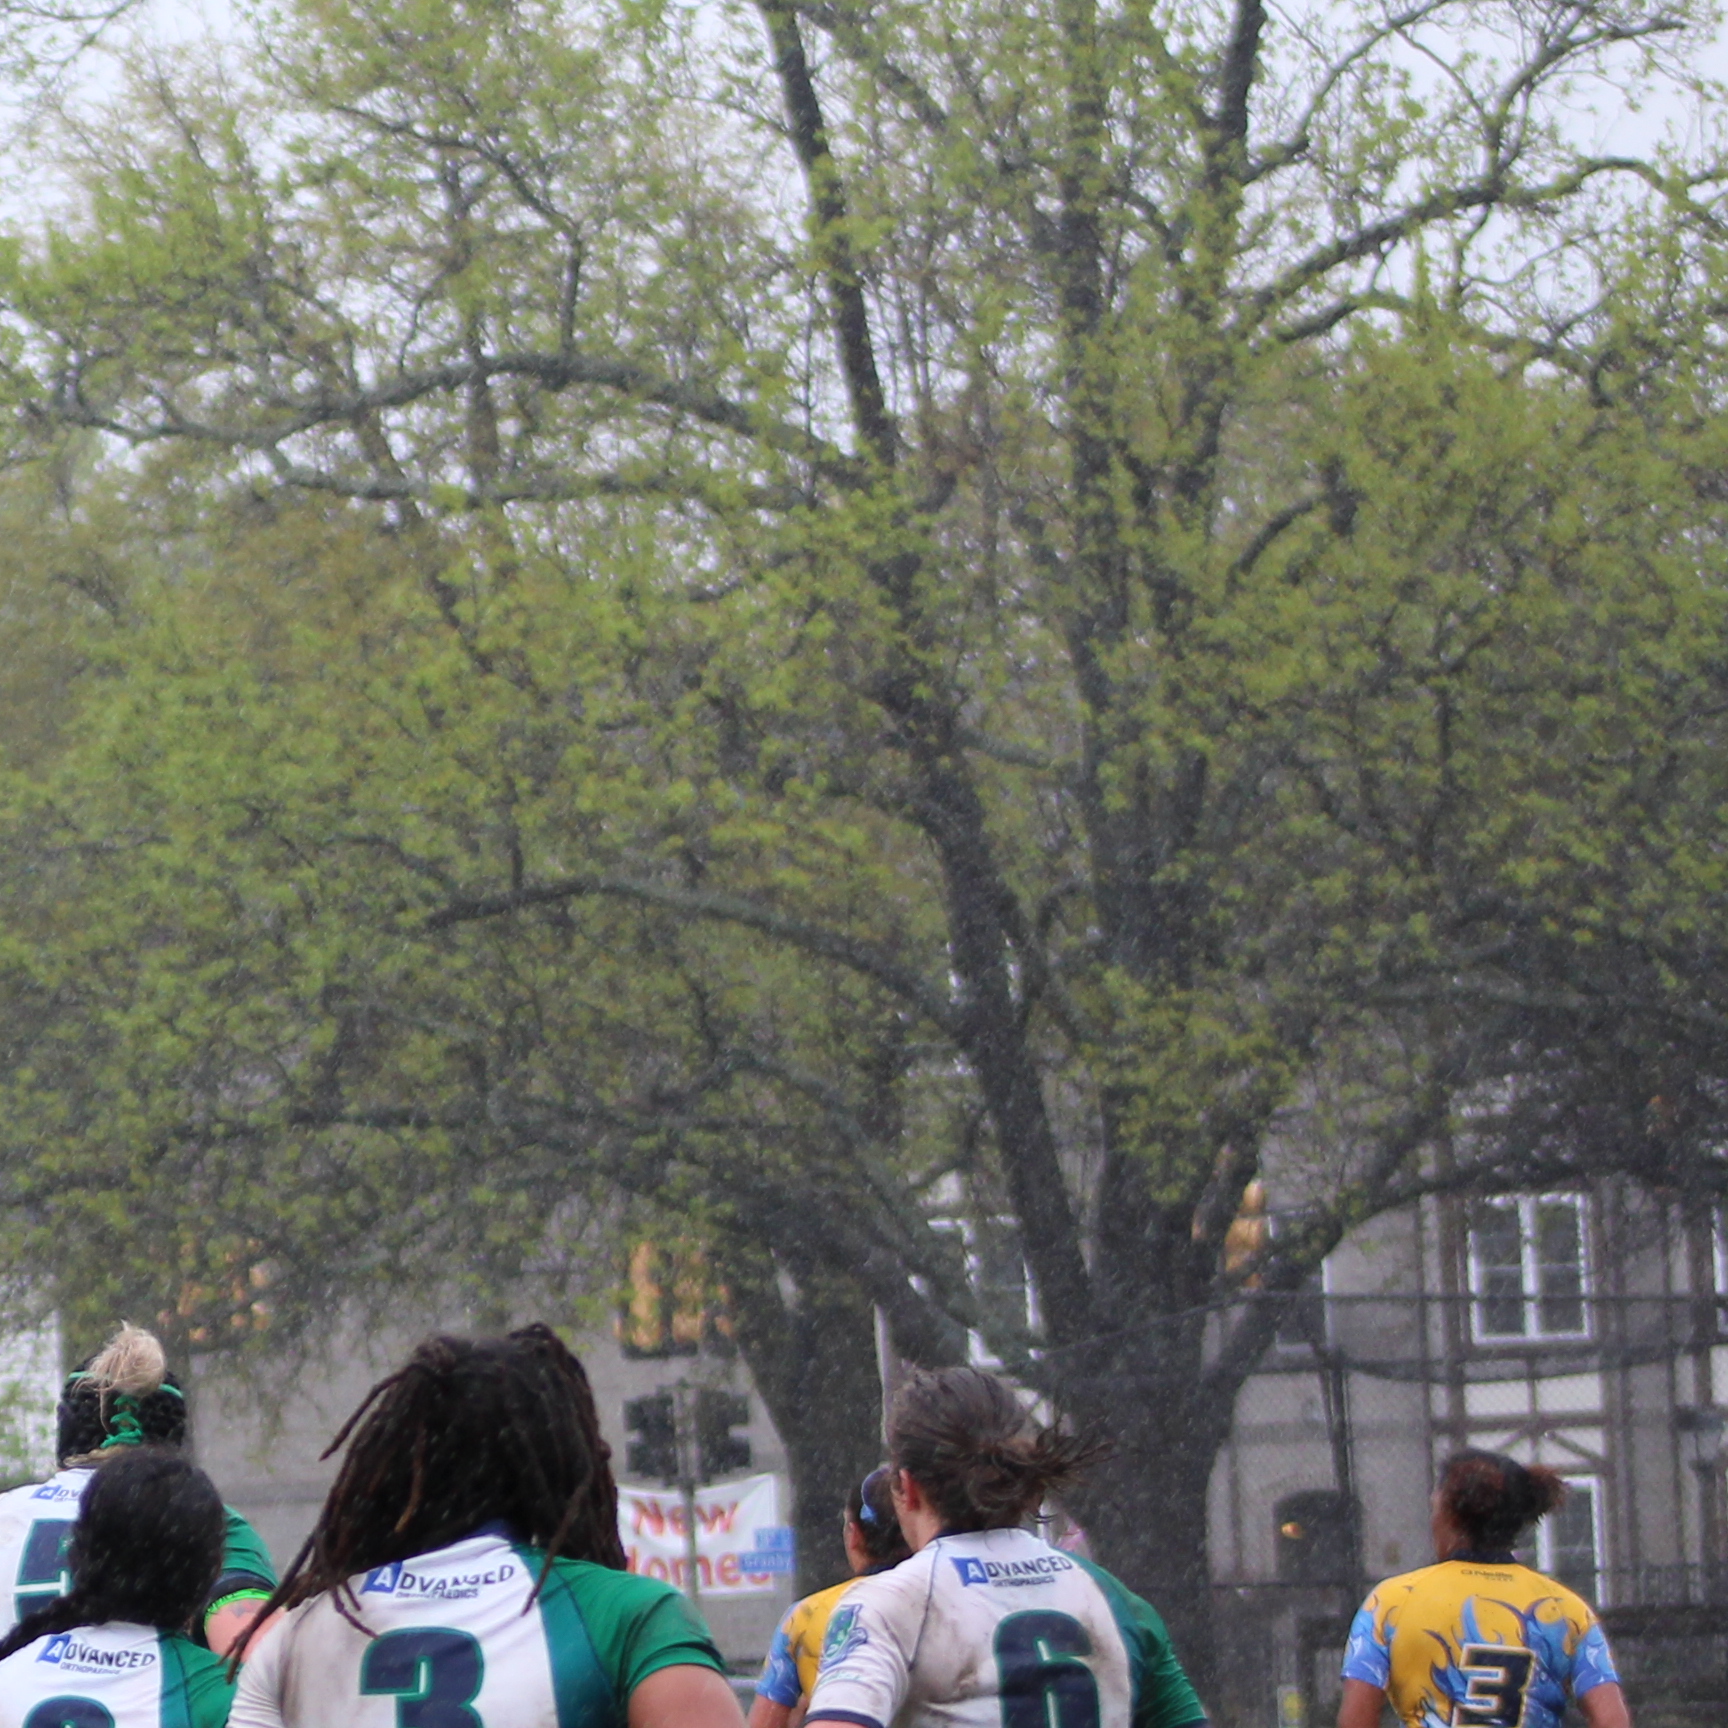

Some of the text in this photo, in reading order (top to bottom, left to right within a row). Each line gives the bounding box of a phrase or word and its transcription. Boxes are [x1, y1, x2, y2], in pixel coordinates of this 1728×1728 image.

[631, 1498, 741, 1537] New
[626, 1548, 771, 1587] ome
[966, 1556, 1073, 1579] ADVANCED
[47, 1640, 156, 1668] ADVANCED
